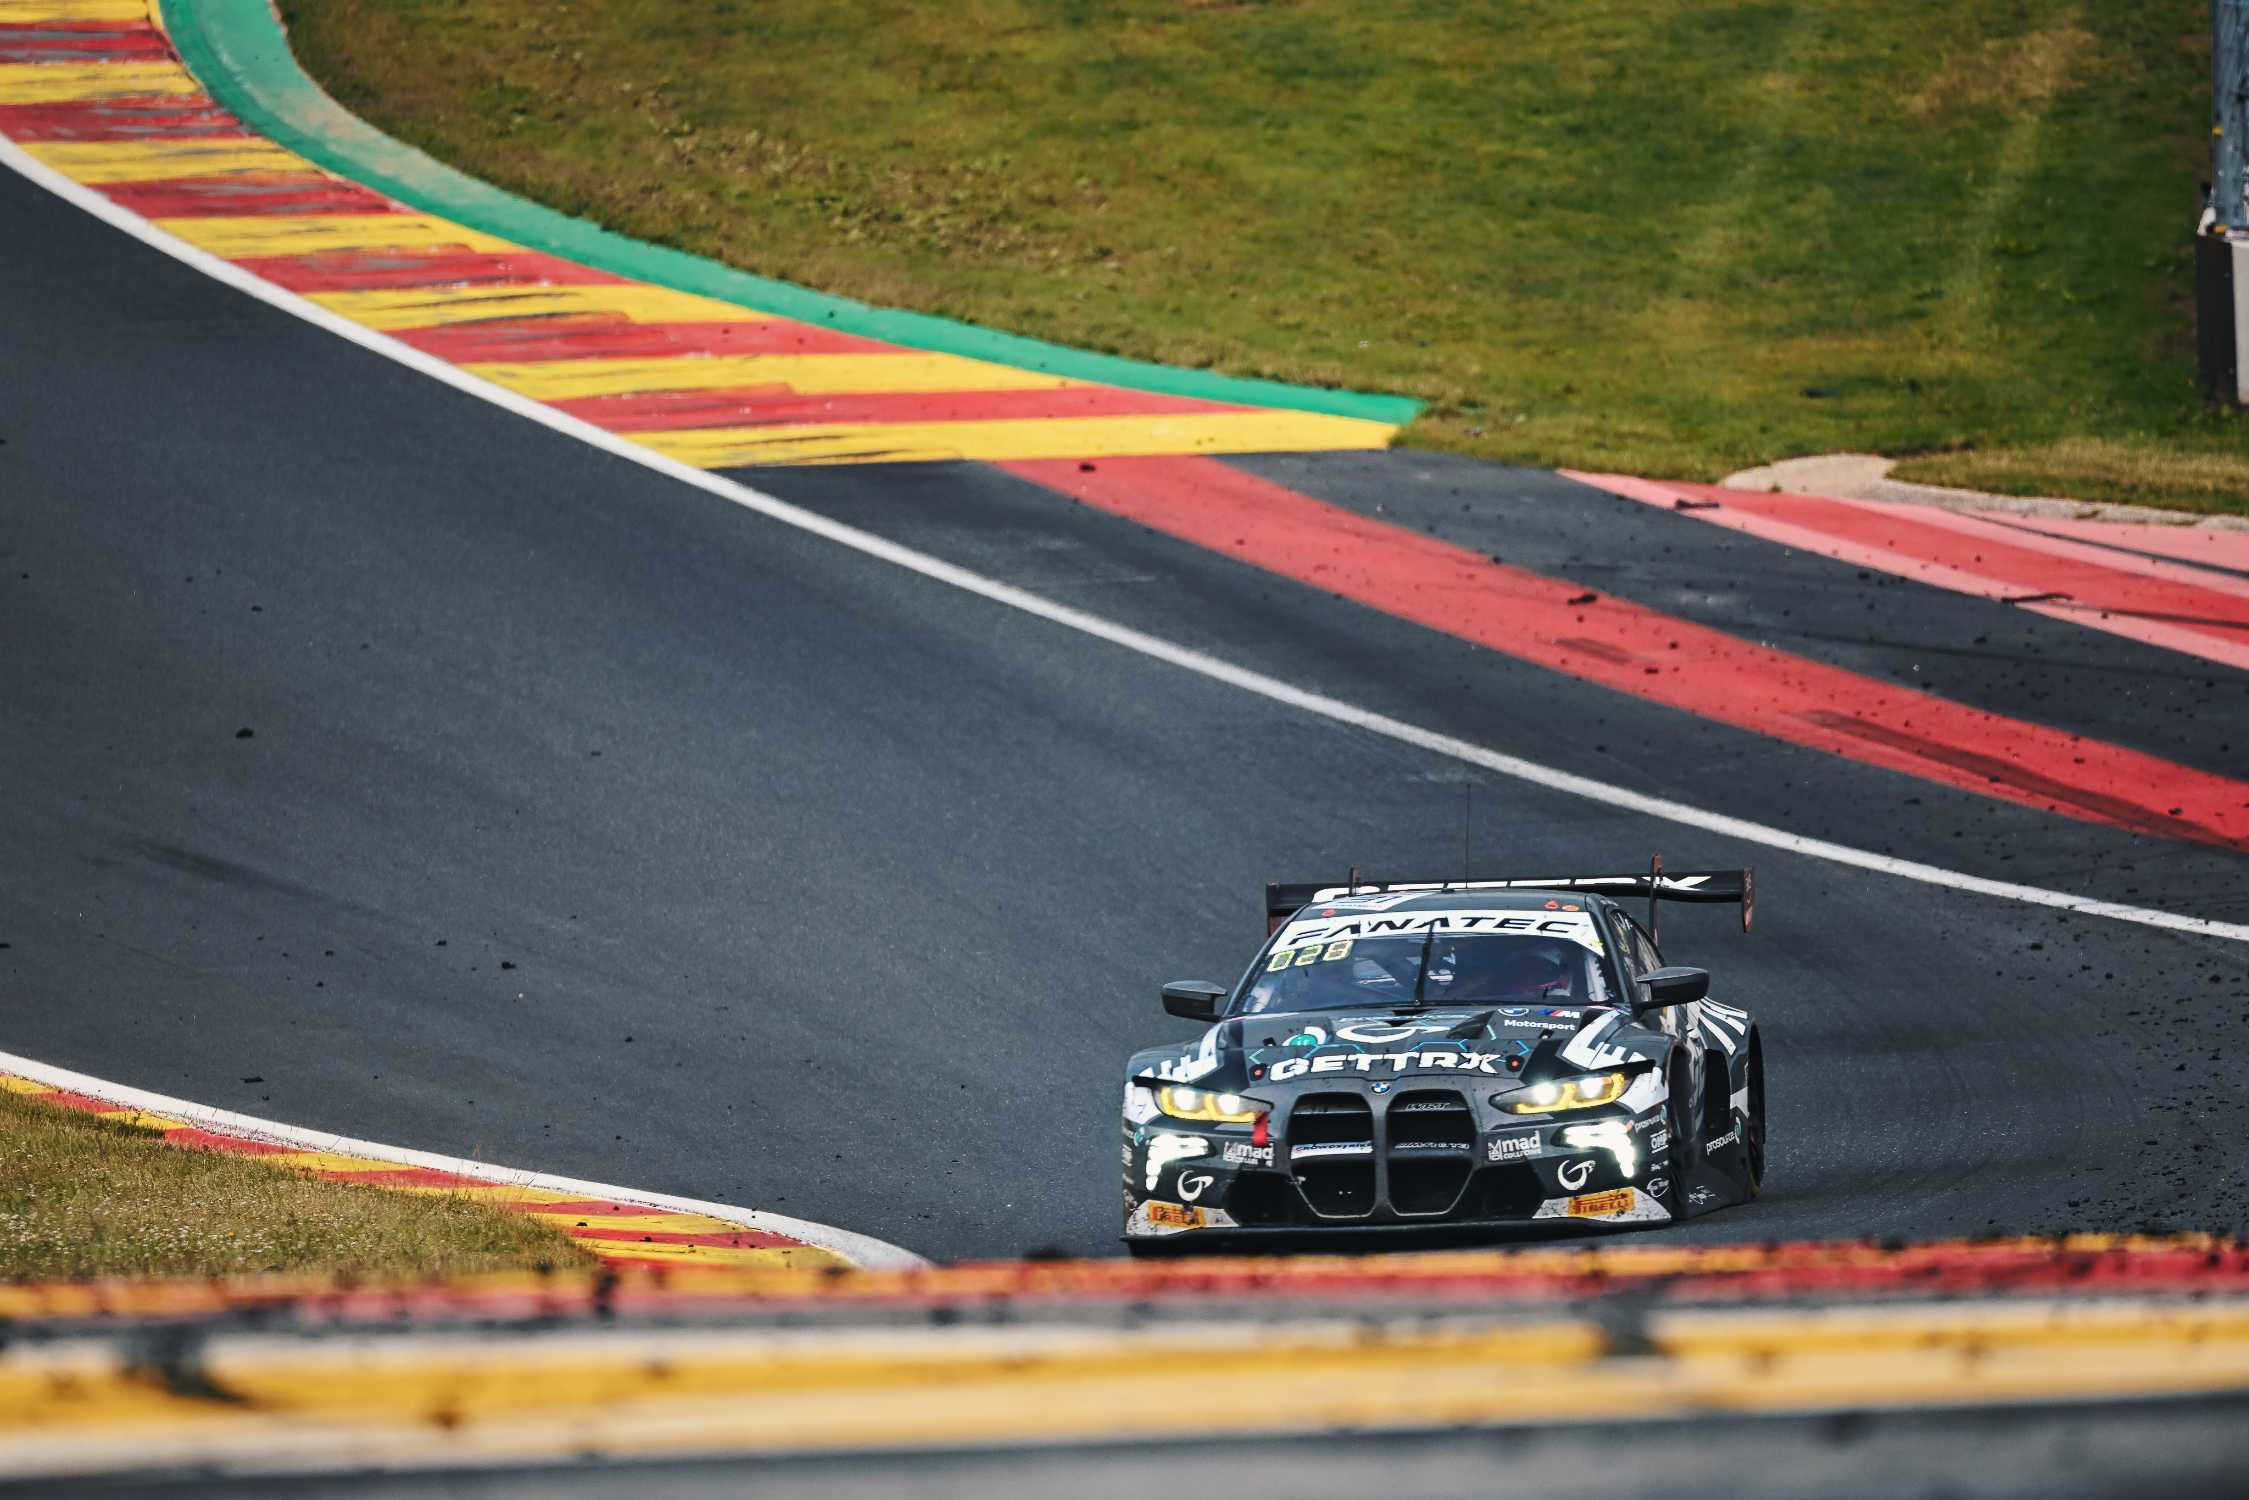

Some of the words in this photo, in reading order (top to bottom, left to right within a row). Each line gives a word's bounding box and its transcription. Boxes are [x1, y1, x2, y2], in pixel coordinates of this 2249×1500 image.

[1289, 917, 1579, 945] FANATEC
[1266, 940, 1353, 972] 028
[1504, 1019, 1576, 1031] Motorsport
[1269, 1051, 1501, 1082] GETTRX
[1238, 1143, 1275, 1160] mad
[1502, 1130, 1541, 1153] mad
[1573, 1193, 1629, 1215] PIRELLI
